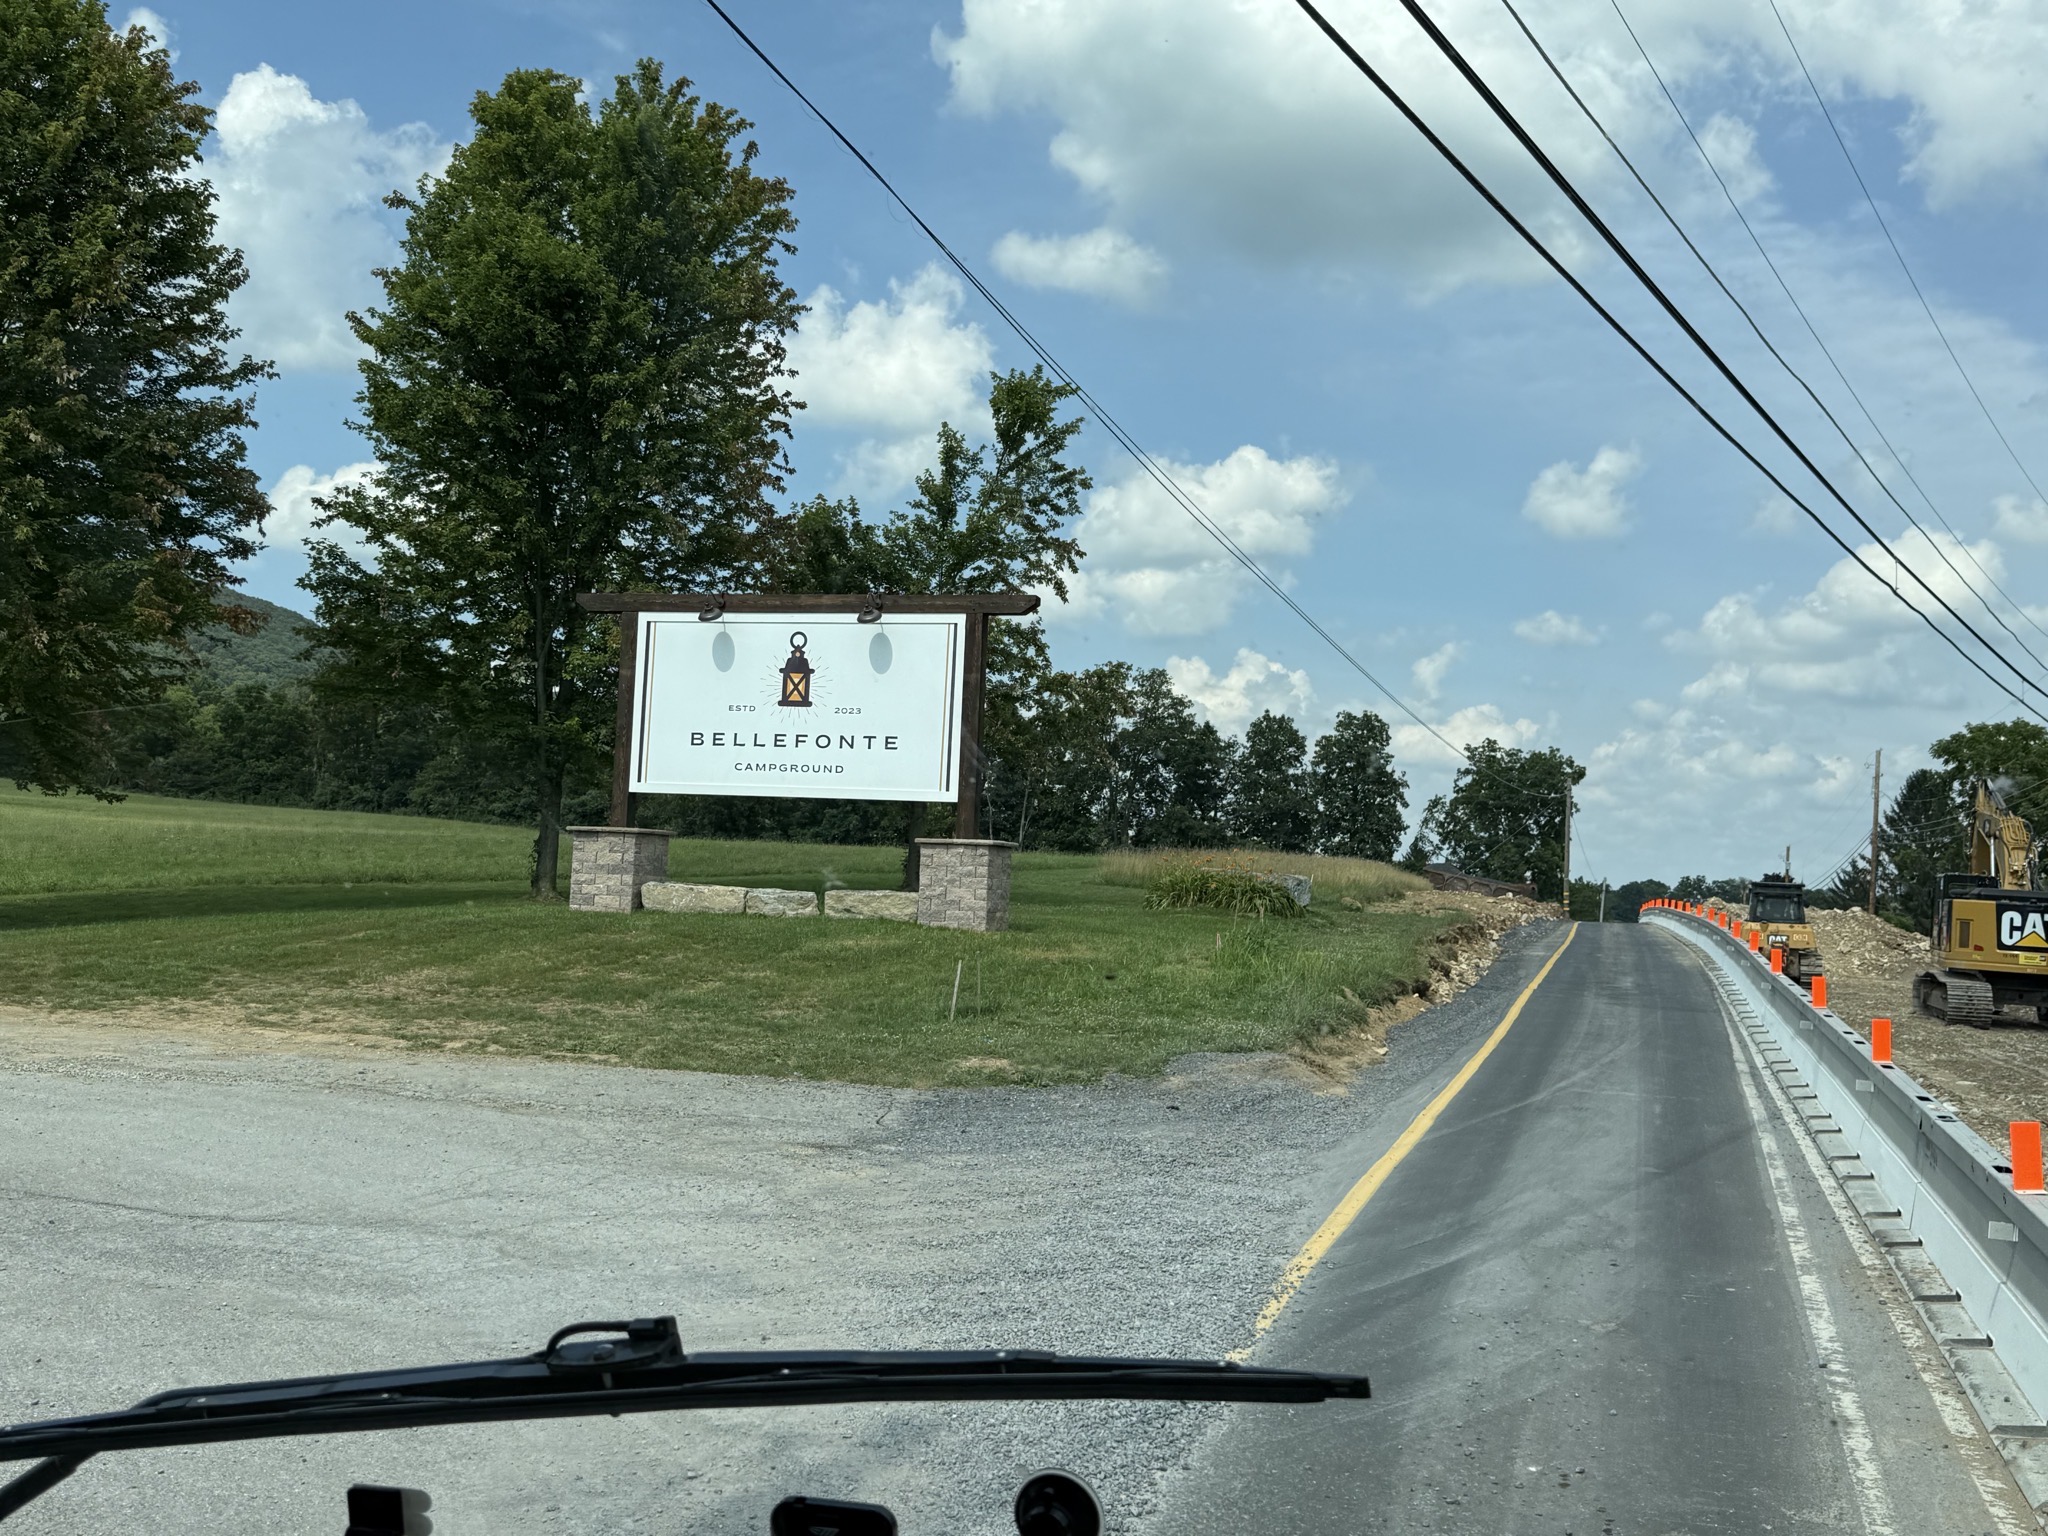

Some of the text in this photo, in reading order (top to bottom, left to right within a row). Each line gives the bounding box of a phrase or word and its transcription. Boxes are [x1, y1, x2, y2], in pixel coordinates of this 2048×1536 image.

[728, 704, 862, 715] ESTD 2023
[690, 732, 899, 751] BELLEFONTE
[734, 762, 844, 774] CAMPGROUND
[2000, 910, 2048, 946] CA
